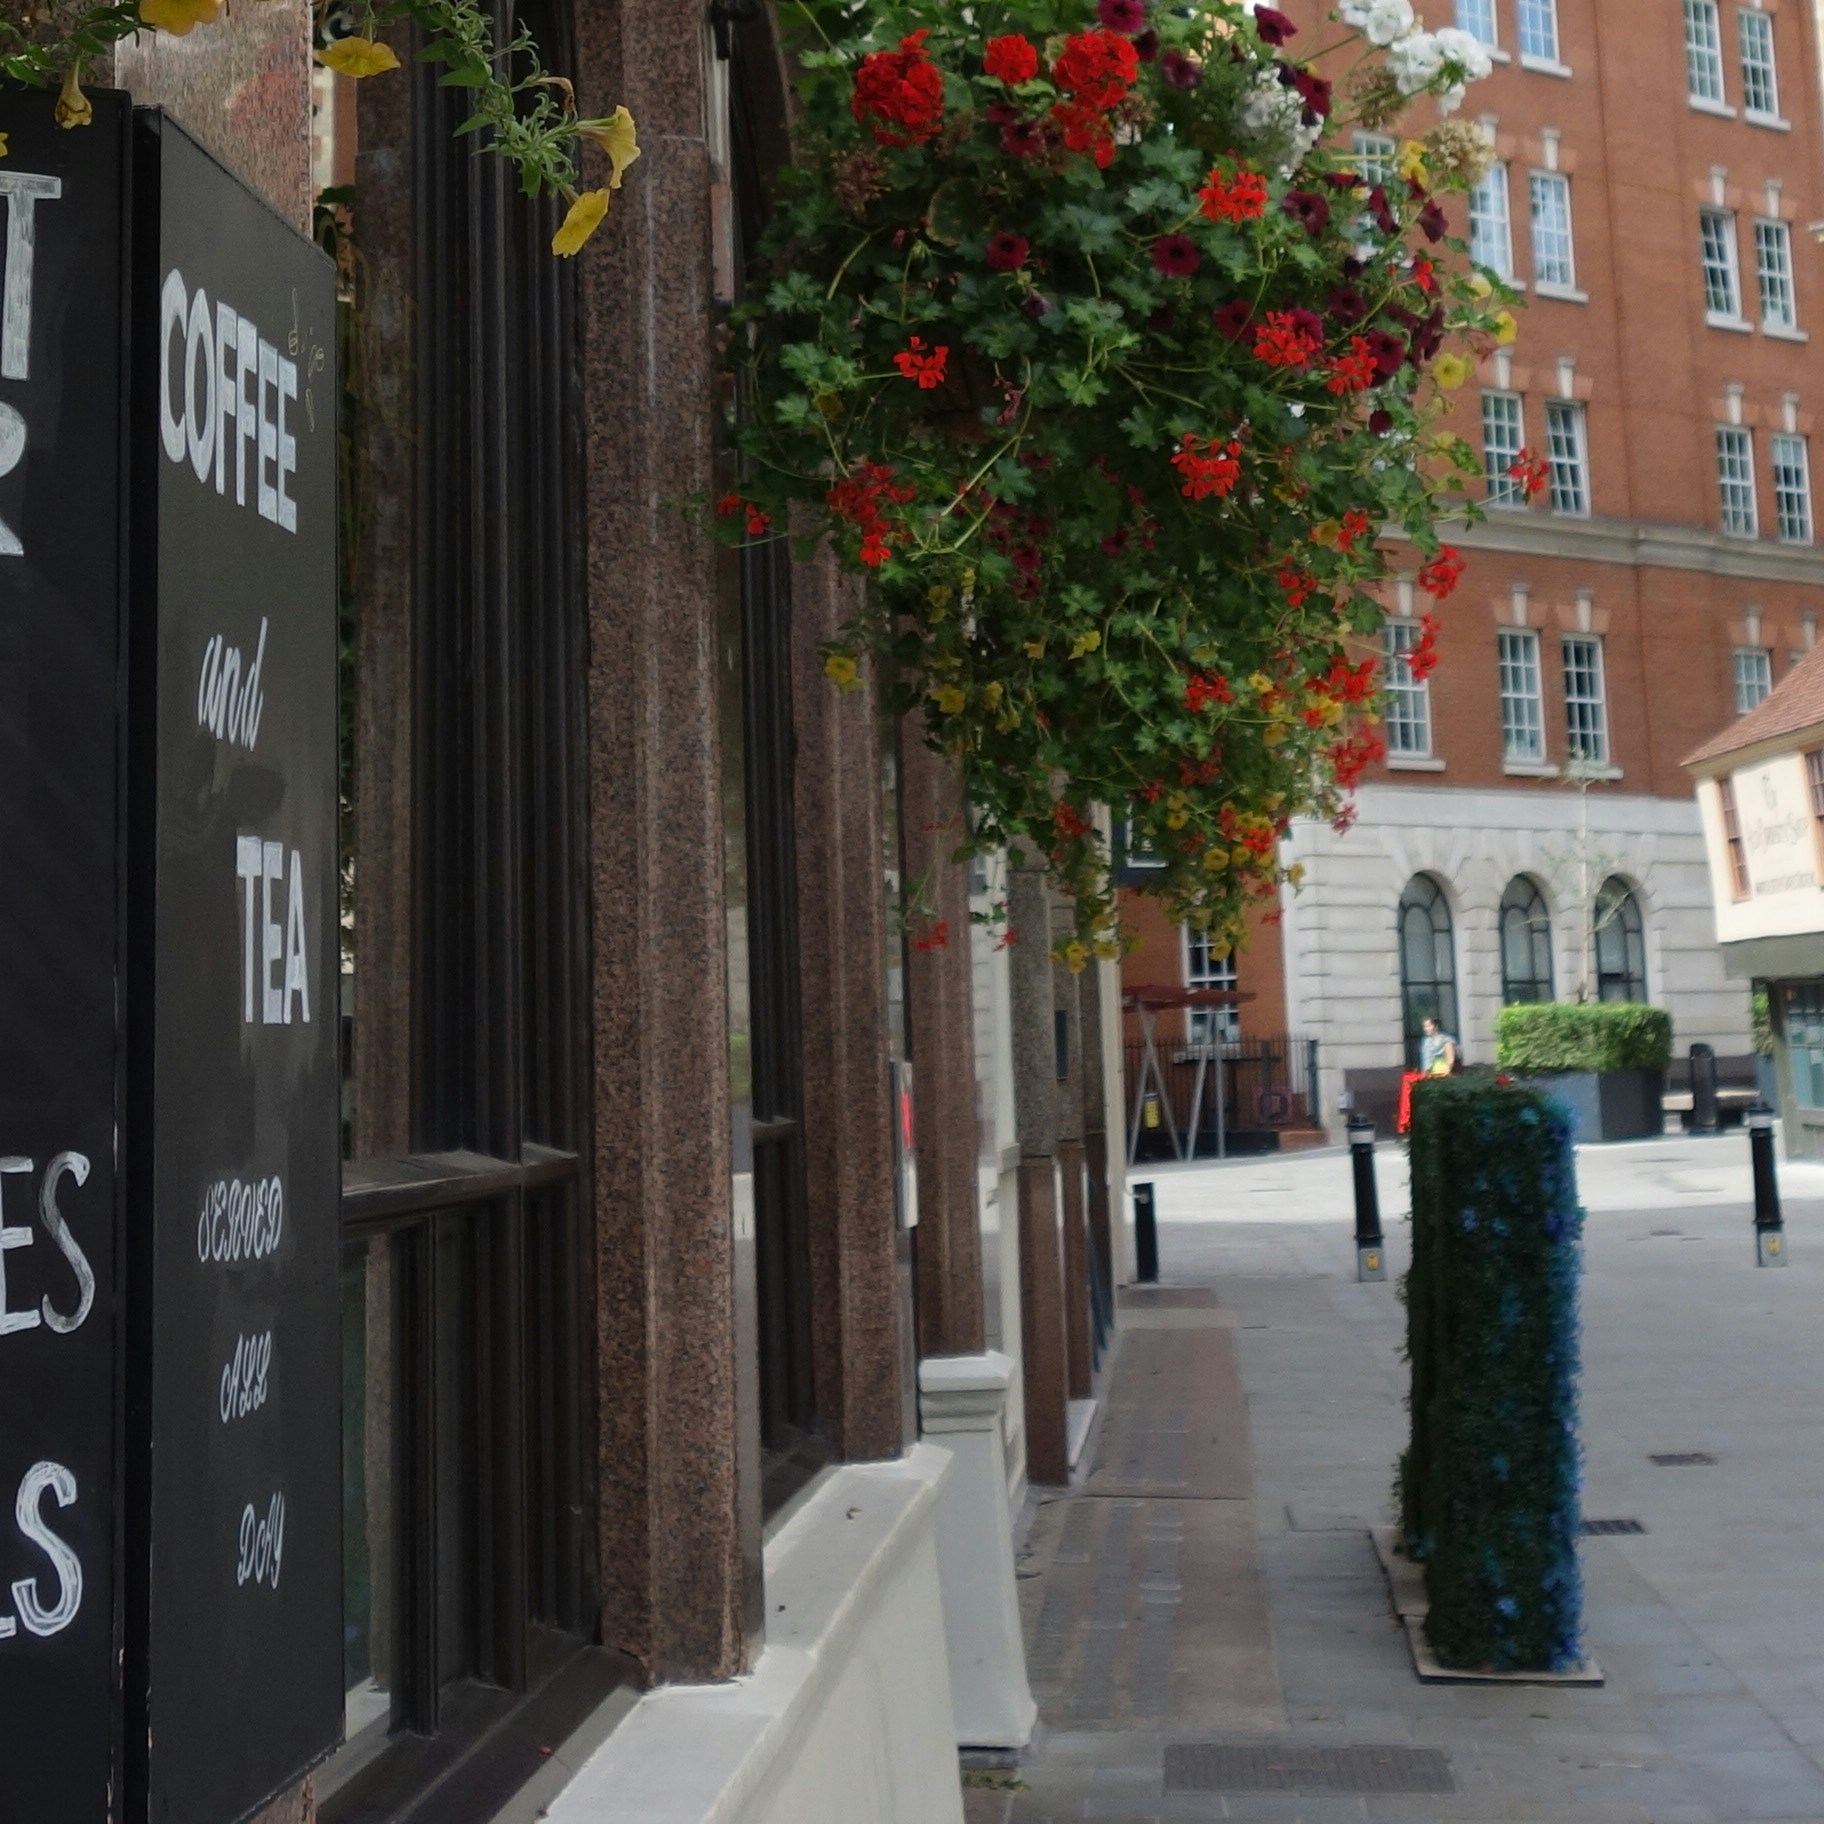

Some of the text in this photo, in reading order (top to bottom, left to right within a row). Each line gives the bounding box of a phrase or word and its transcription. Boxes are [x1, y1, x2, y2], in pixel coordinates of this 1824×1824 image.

[161, 268, 297, 534] COFFEE
[197, 616, 268, 752] and
[237, 835, 310, 1024] TEA
[197, 1175, 283, 1263] SERVED
[220, 1331, 271, 1424] ALL
[237, 1491, 285, 1589] DAY
